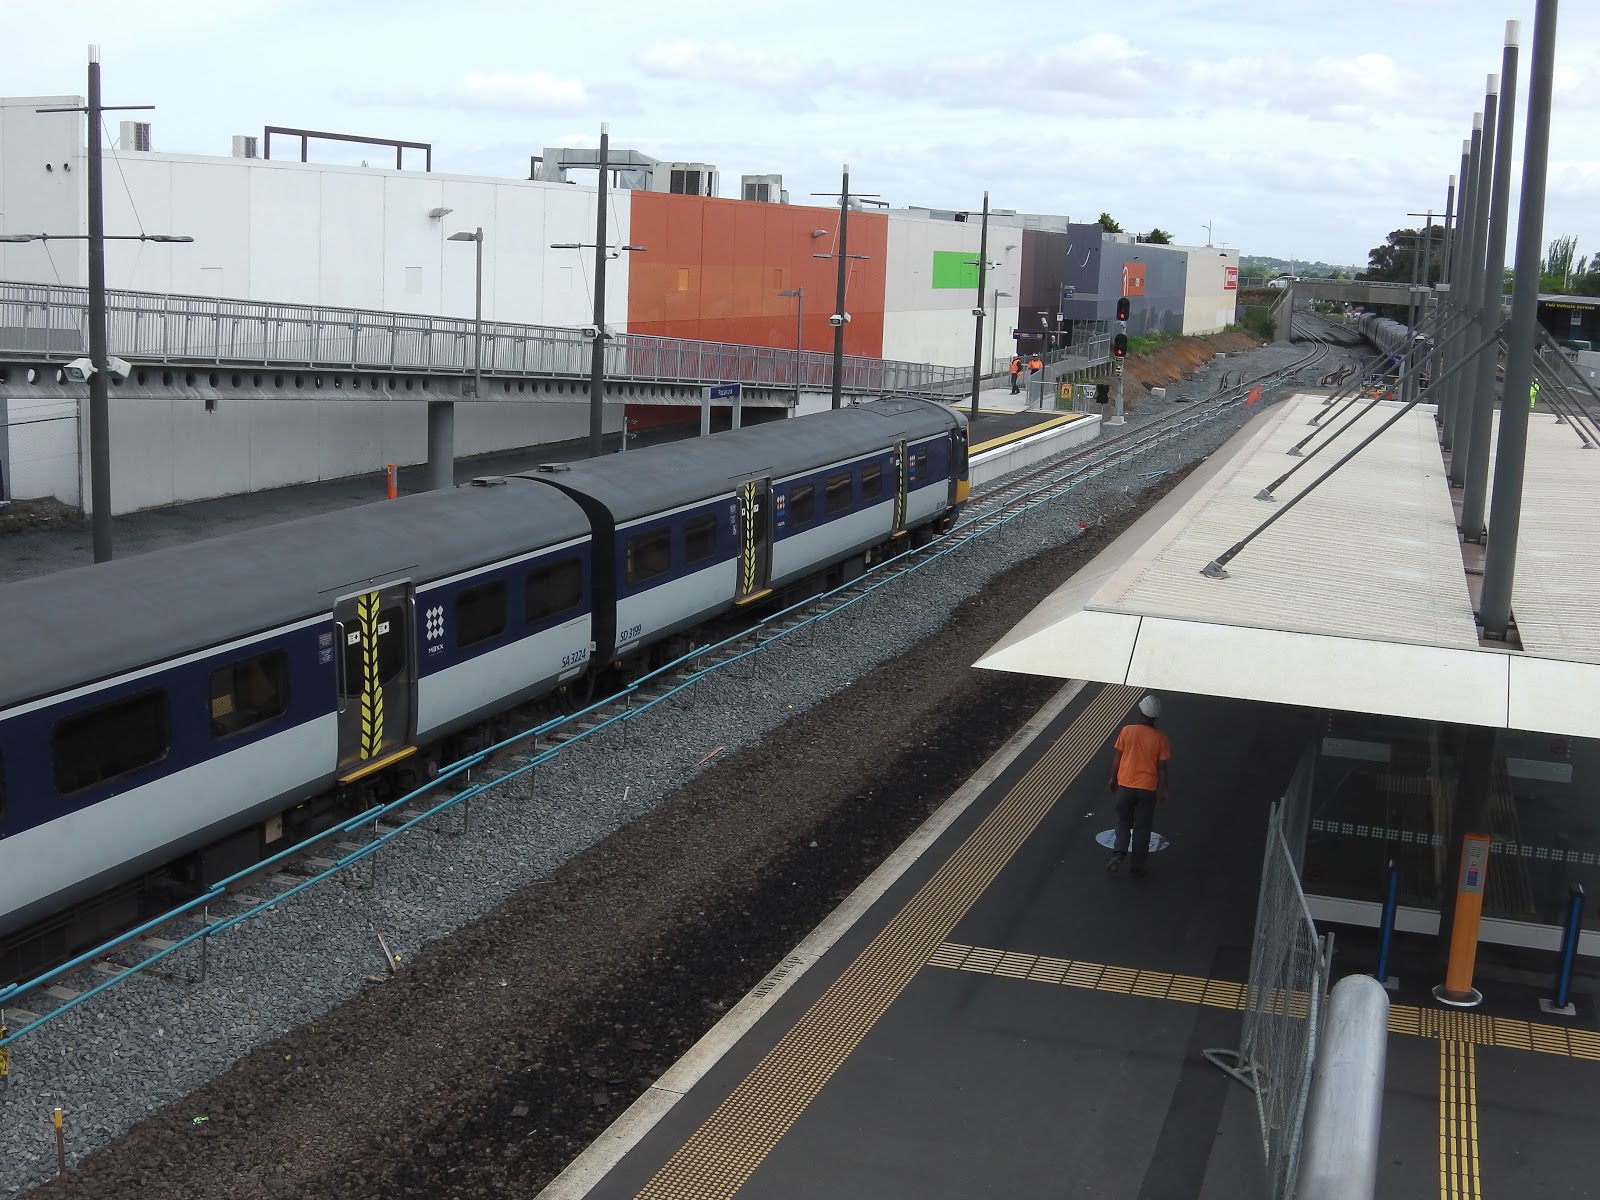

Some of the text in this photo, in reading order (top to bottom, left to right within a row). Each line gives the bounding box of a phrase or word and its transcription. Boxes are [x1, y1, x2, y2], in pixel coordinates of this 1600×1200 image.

[620, 624, 642, 643] SD 3199
[561, 648, 586, 669] SA 3224
